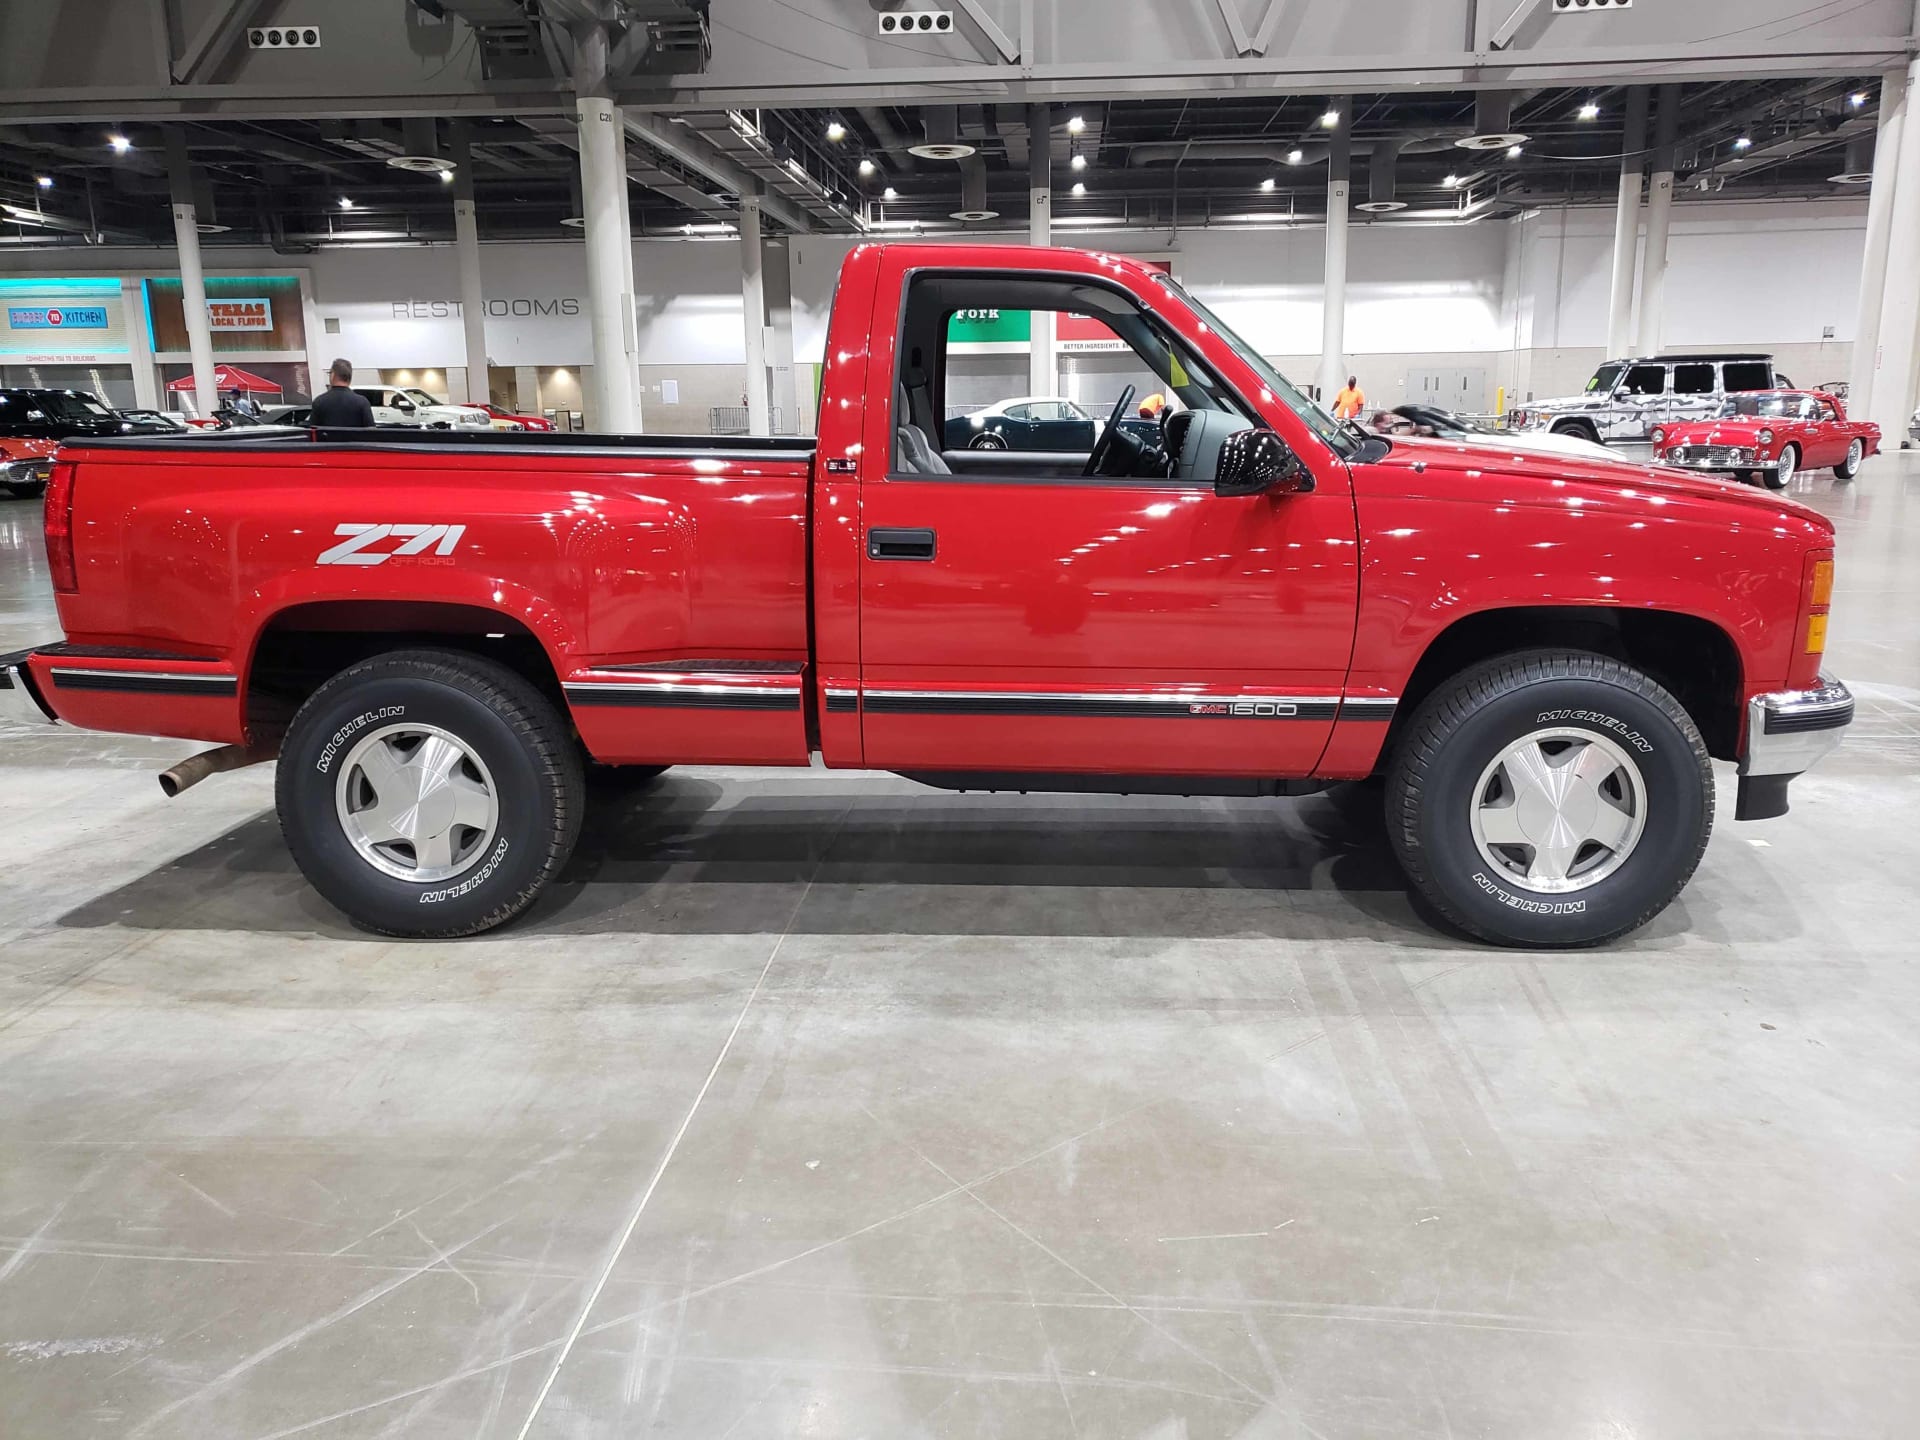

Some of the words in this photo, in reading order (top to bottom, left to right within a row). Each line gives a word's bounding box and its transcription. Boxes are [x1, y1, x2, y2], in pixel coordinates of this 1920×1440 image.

[65, 311, 103, 324] KITCHEN
[210, 303, 265, 316] TEXAS
[391, 298, 580, 319] RESTOOMS
[211, 317, 235, 327] LOCAL
[237, 317, 267, 327] FLAVOR
[316, 523, 466, 565] Z71
[389, 557, 416, 567] OFF
[417, 557, 456, 566] ROAD
[1189, 704, 1227, 714] GMC
[1228, 704, 1297, 716] 1500
[316, 705, 405, 773] MICHELIN
[1536, 709, 1654, 753] MICHELIN
[419, 837, 509, 903] MICHELIN
[1472, 872, 1586, 914] MICHELIN
